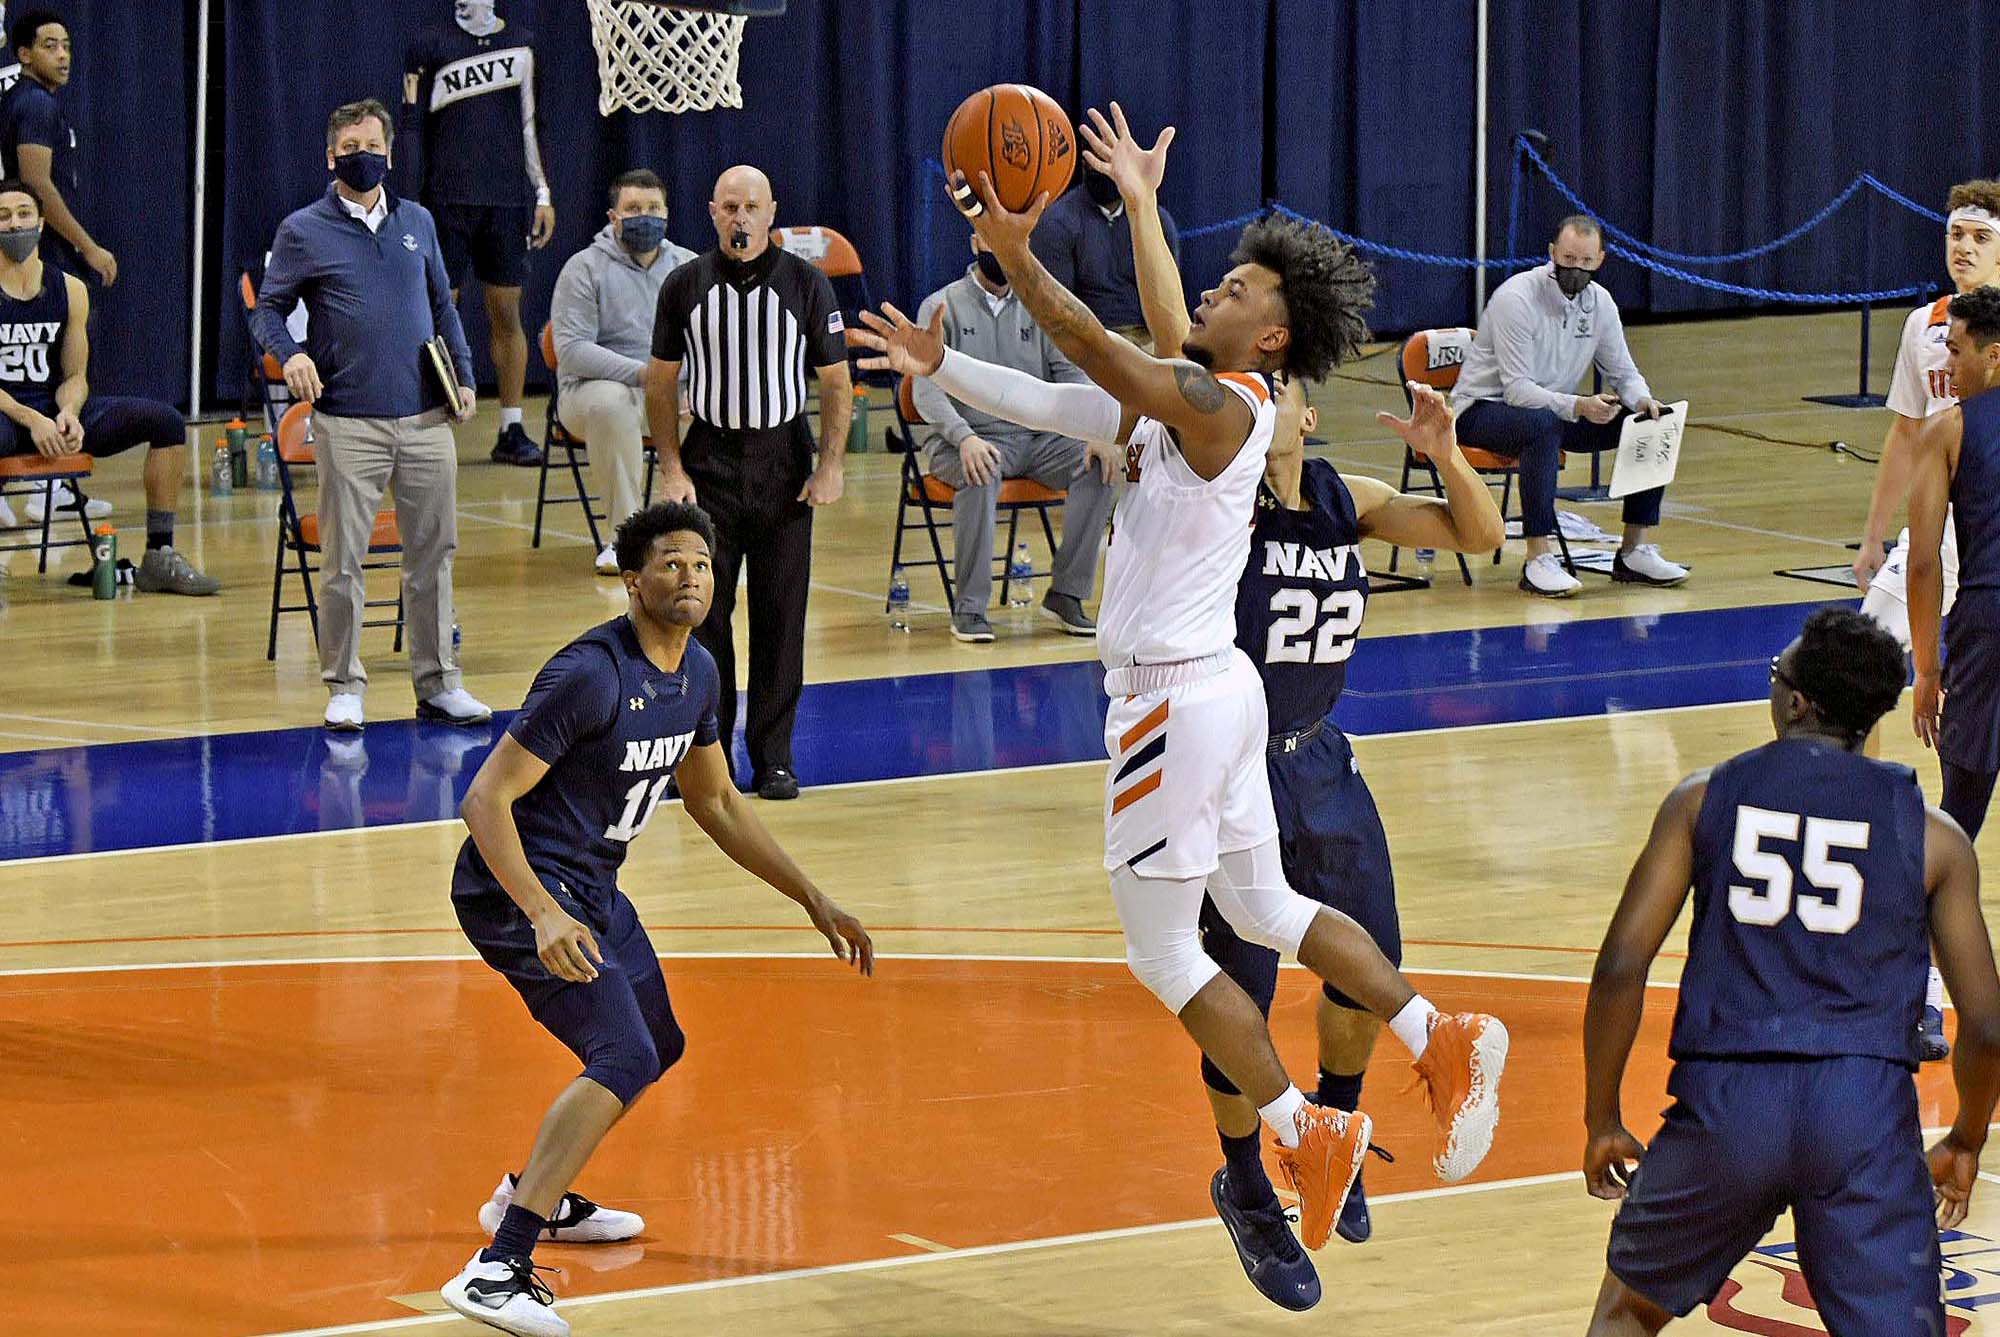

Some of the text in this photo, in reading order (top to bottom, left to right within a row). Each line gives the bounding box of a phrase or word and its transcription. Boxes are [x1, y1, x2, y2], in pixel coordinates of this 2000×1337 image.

[442, 57, 515, 94] NAVY
[0, 343, 50, 382] 20
[1265, 588, 1364, 664] 22
[603, 774, 671, 842] 11
[1727, 804, 1871, 935] 55
